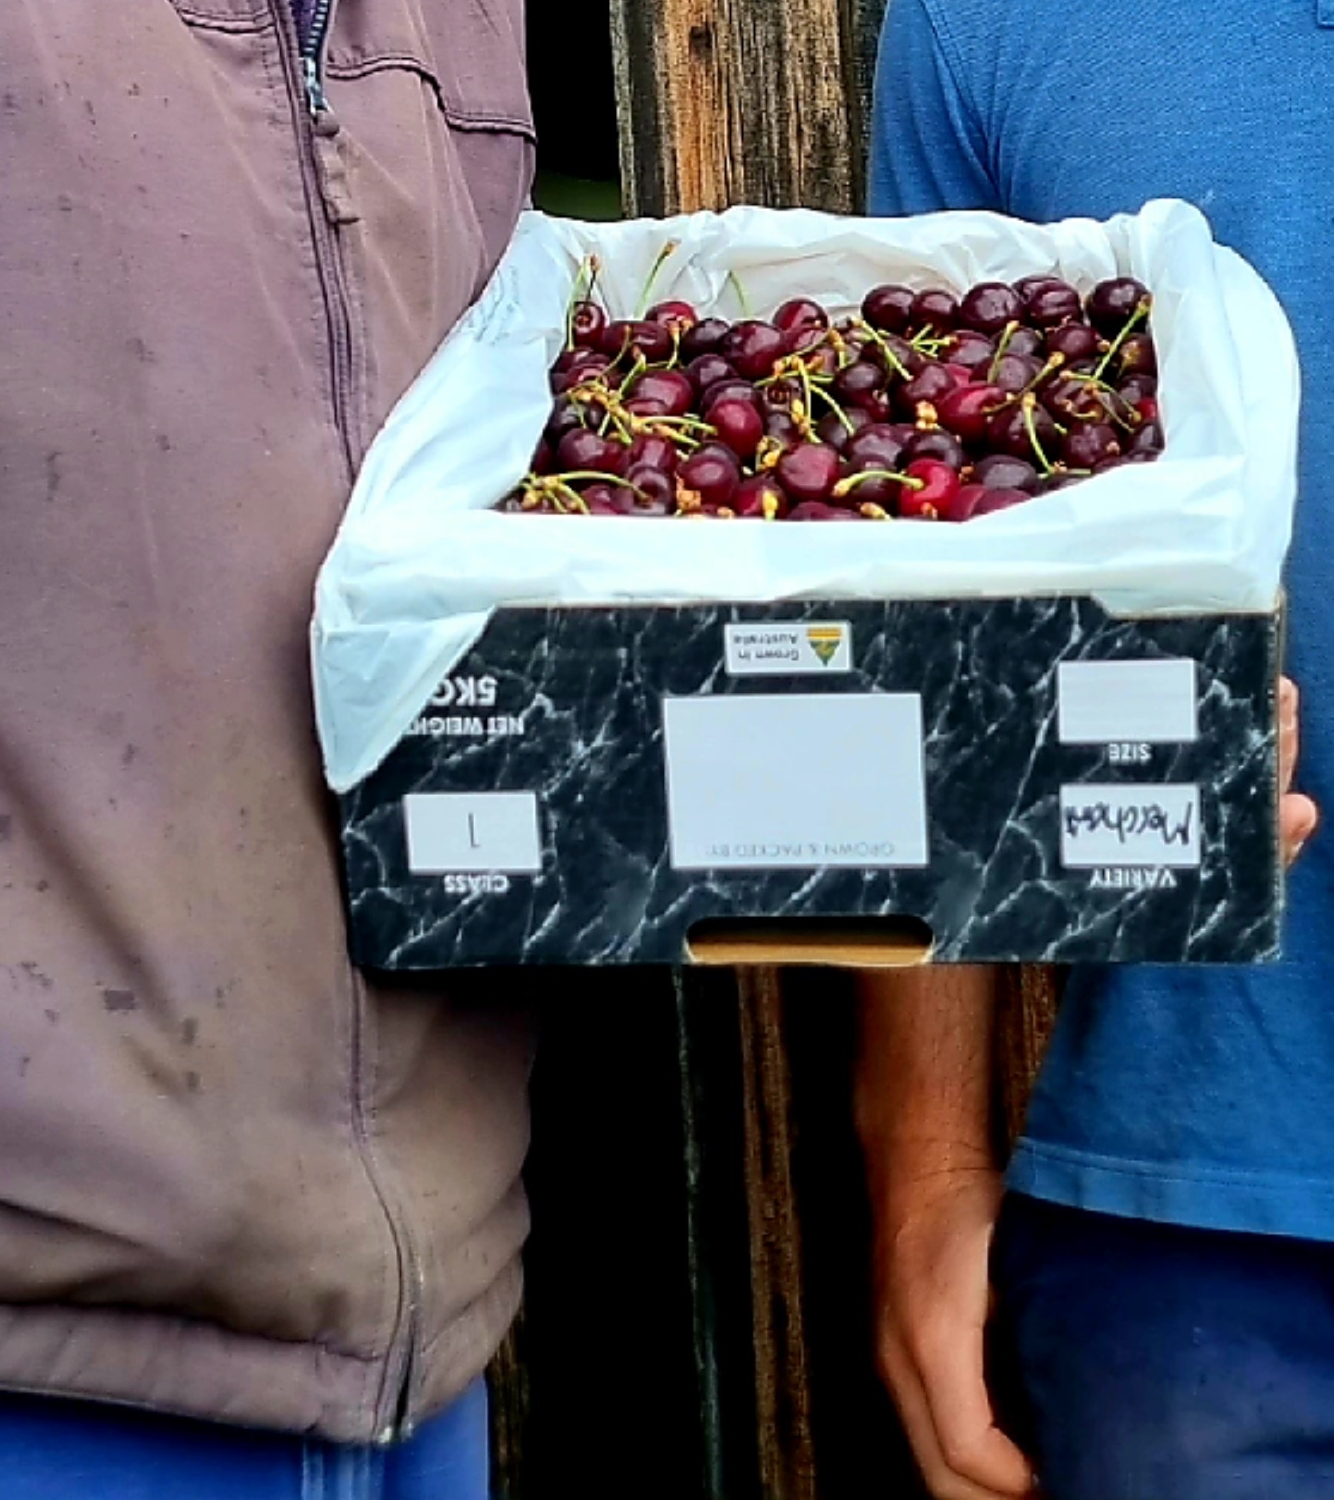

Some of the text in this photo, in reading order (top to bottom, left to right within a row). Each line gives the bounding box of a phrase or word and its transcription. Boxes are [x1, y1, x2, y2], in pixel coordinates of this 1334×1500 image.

[733, 633, 799, 645] Australia
[738, 649, 800, 662] Grown in
[487, 715, 525, 736] NET
[1107, 742, 1153, 762] SIZE
[734, 843, 802, 858] PACKED
[824, 841, 895, 857] GROWN
[443, 874, 510, 894] CLASS
[1088, 867, 1178, 889] VARIETY
